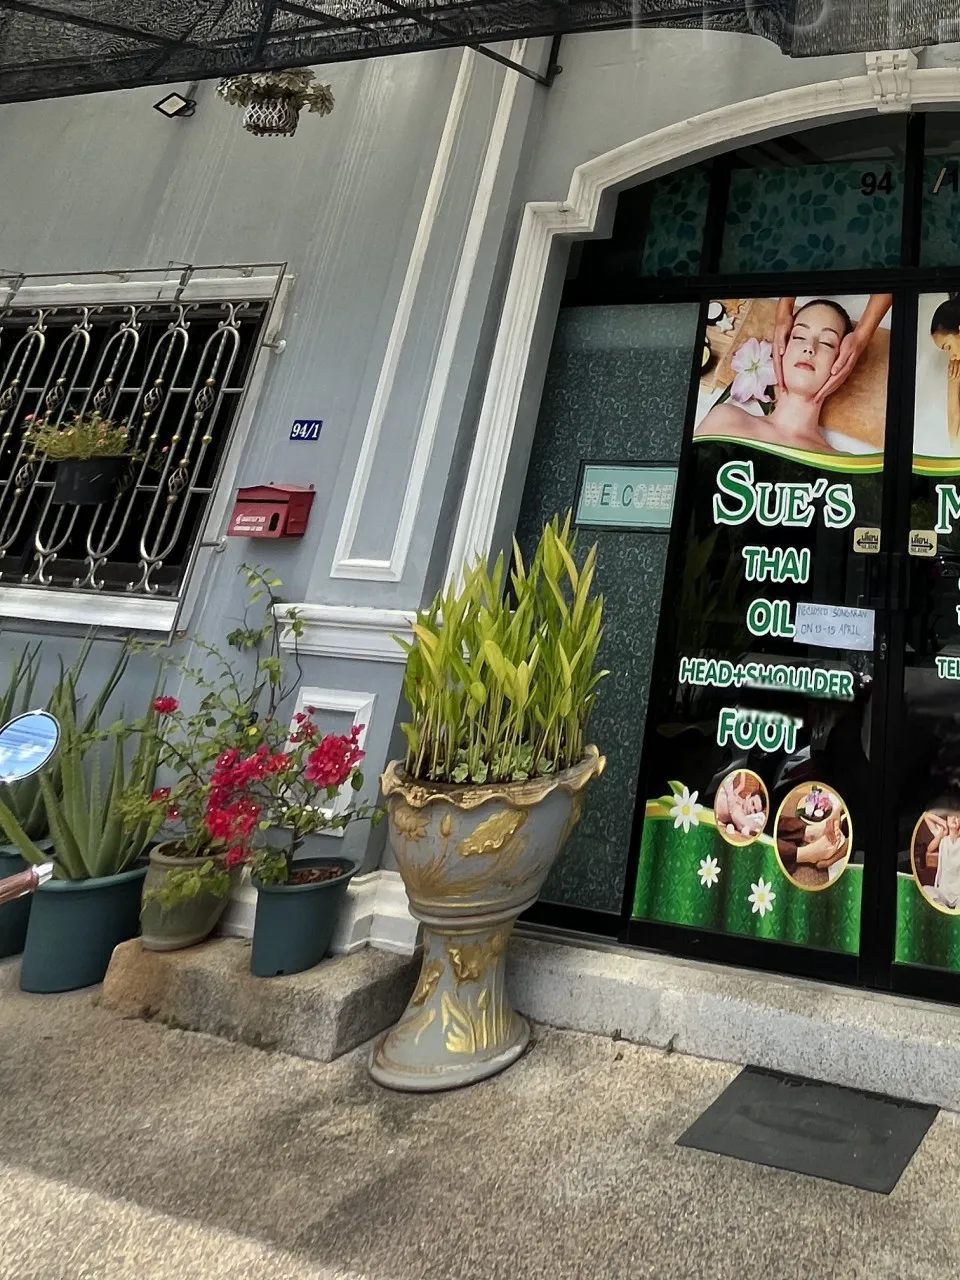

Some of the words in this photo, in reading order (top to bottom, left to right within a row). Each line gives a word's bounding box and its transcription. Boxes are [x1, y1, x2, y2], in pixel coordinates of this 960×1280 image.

[860, 171, 893, 196] 94
[291, 422, 319, 439] 94/1
[584, 482, 673, 510] WELCOME
[742, 546, 810, 583] THAI
[746, 598, 797, 637] OIL
[679, 656, 855, 701] HEAD+SHOULDER
[716, 707, 803, 754] FOOT
